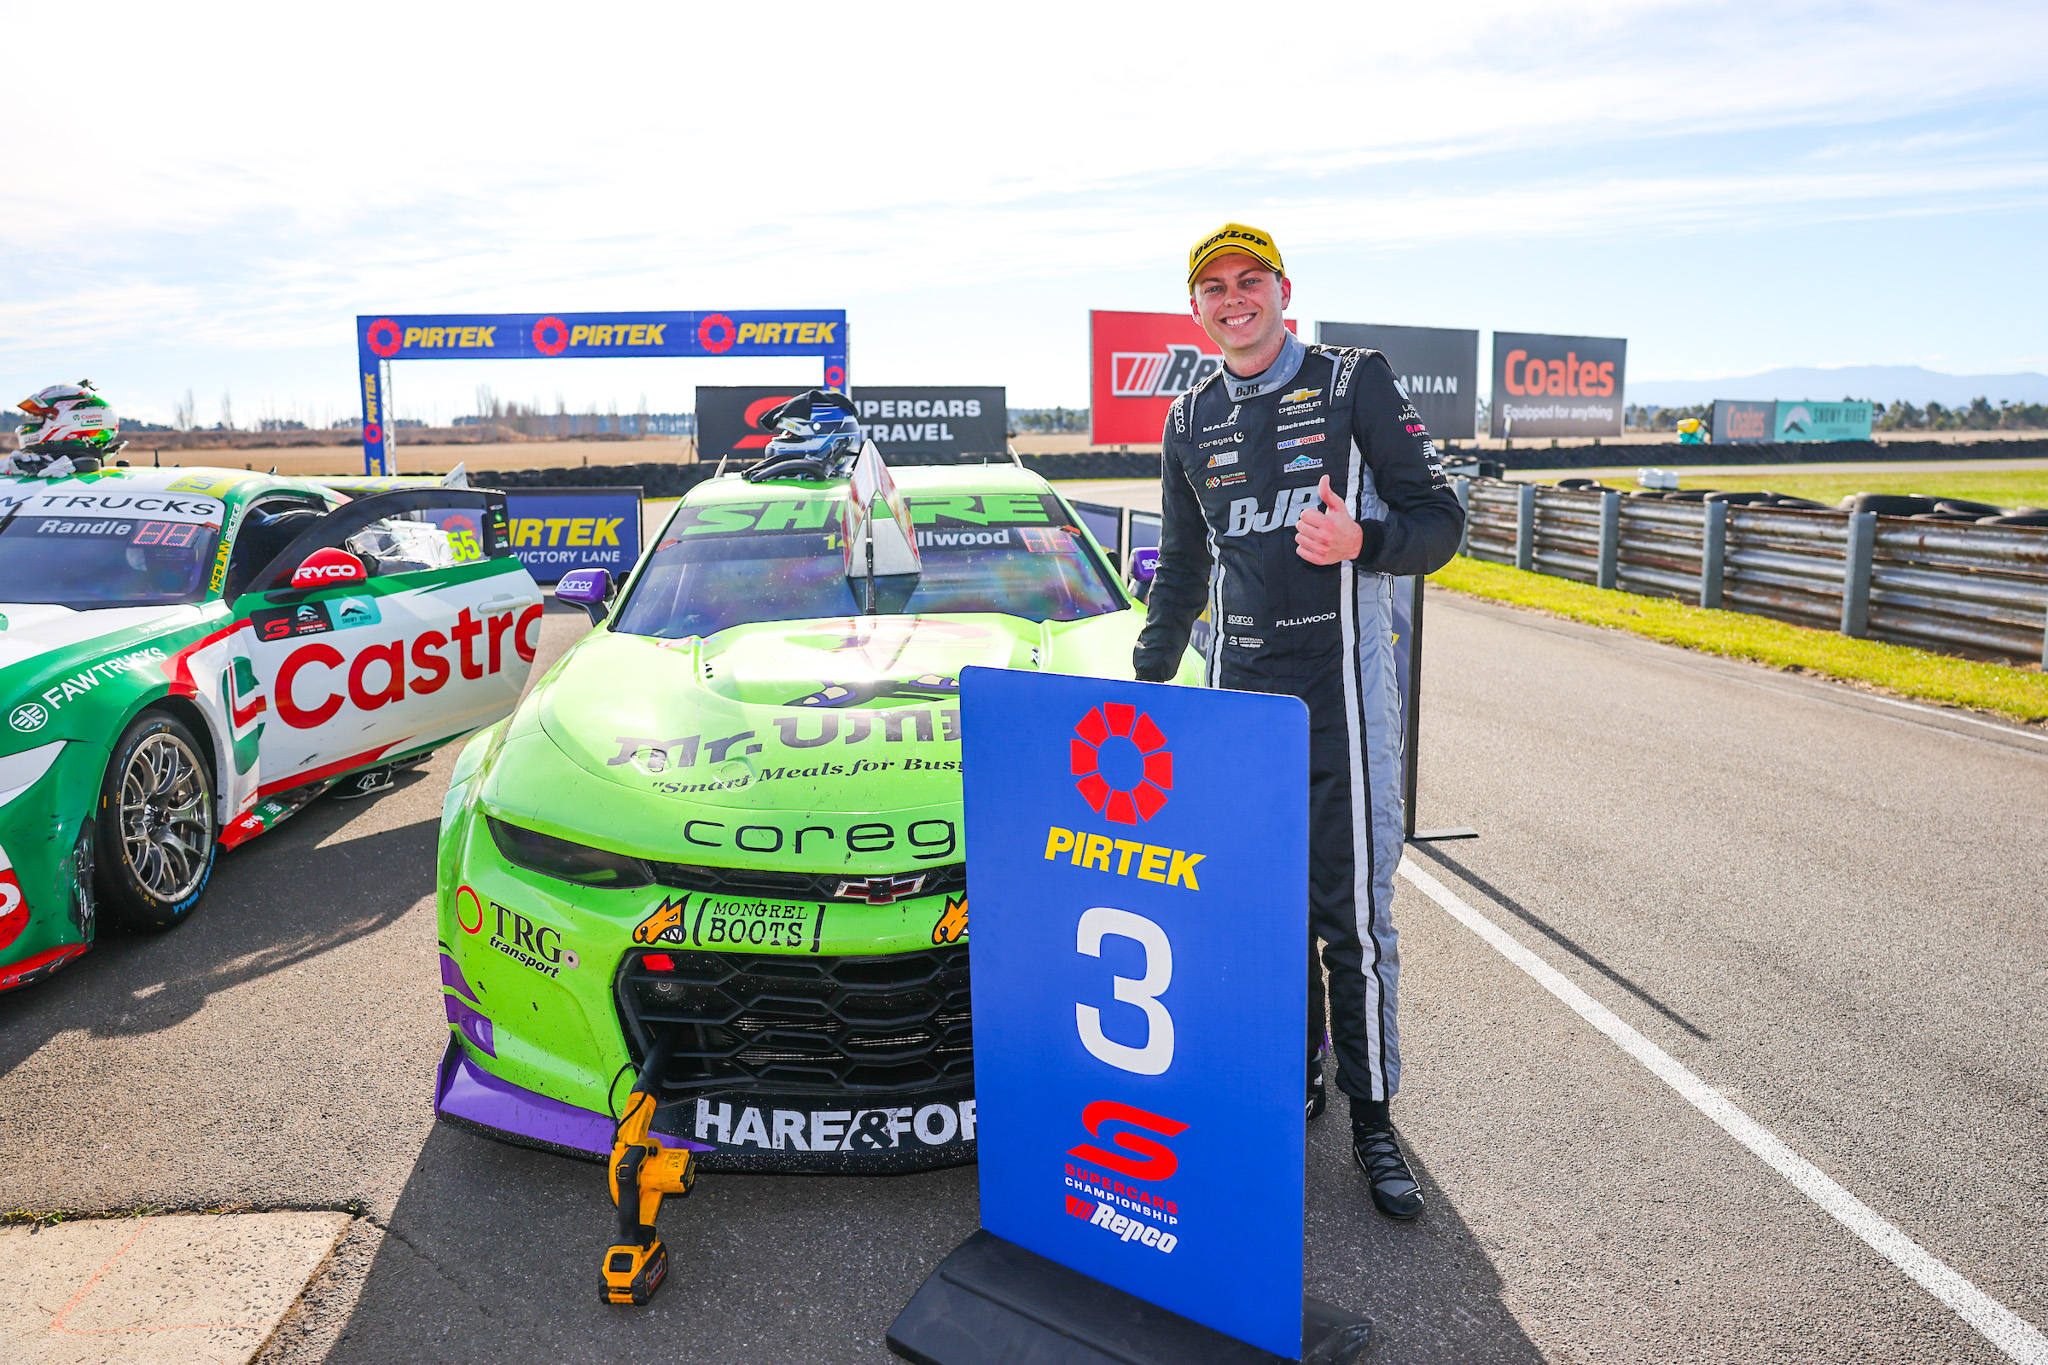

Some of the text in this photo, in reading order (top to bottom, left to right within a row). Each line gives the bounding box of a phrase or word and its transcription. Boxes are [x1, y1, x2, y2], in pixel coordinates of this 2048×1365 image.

[1193, 231, 1268, 262] DUNLOP
[404, 326, 497, 347] PIRTEK
[569, 324, 667, 346] PIRTEK
[737, 322, 839, 344] PIRTEK
[1504, 349, 1615, 398] Coates
[364, 372, 378, 424] PIRTEK
[1278, 400, 1322, 414] CHEVROLET
[1202, 421, 1238, 432] MACK
[1277, 417, 1326, 432] Blackwoods
[1503, 404, 1614, 422] Equipped for anything
[1726, 405, 1766, 439] Coates
[859, 423, 954, 442] TRAVEL
[1198, 436, 1234, 450] coregas
[42, 496, 216, 516] TRUCKS
[681, 494, 1050, 536] SHRE
[1223, 485, 1323, 537] BJR
[37, 519, 132, 536] Randle
[225, 502, 242, 542] electrical
[446, 530, 480, 562] 55
[514, 550, 620, 564] VICTORY LANE
[295, 564, 356, 580] RYCO
[1227, 615, 1254, 625] sparco
[1275, 612, 1337, 628] FULLWOOD
[42, 647, 168, 710] FAW TRUCKS
[757, 762, 844, 783] Meals
[847, 757, 895, 777] for
[684, 819, 956, 859] coreg
[1044, 826, 1207, 891] PIRTEK
[712, 901, 808, 921] MONGREL
[489, 900, 563, 964] TRG
[708, 918, 803, 947] BOOTS
[489, 936, 560, 979] transport
[1075, 907, 1175, 1076] 3
[1064, 1177, 1178, 1225] CHAMPIONSHIP
[1065, 1163, 1178, 1214] SUPERCARS
[1090, 1201, 1178, 1254] Repco
